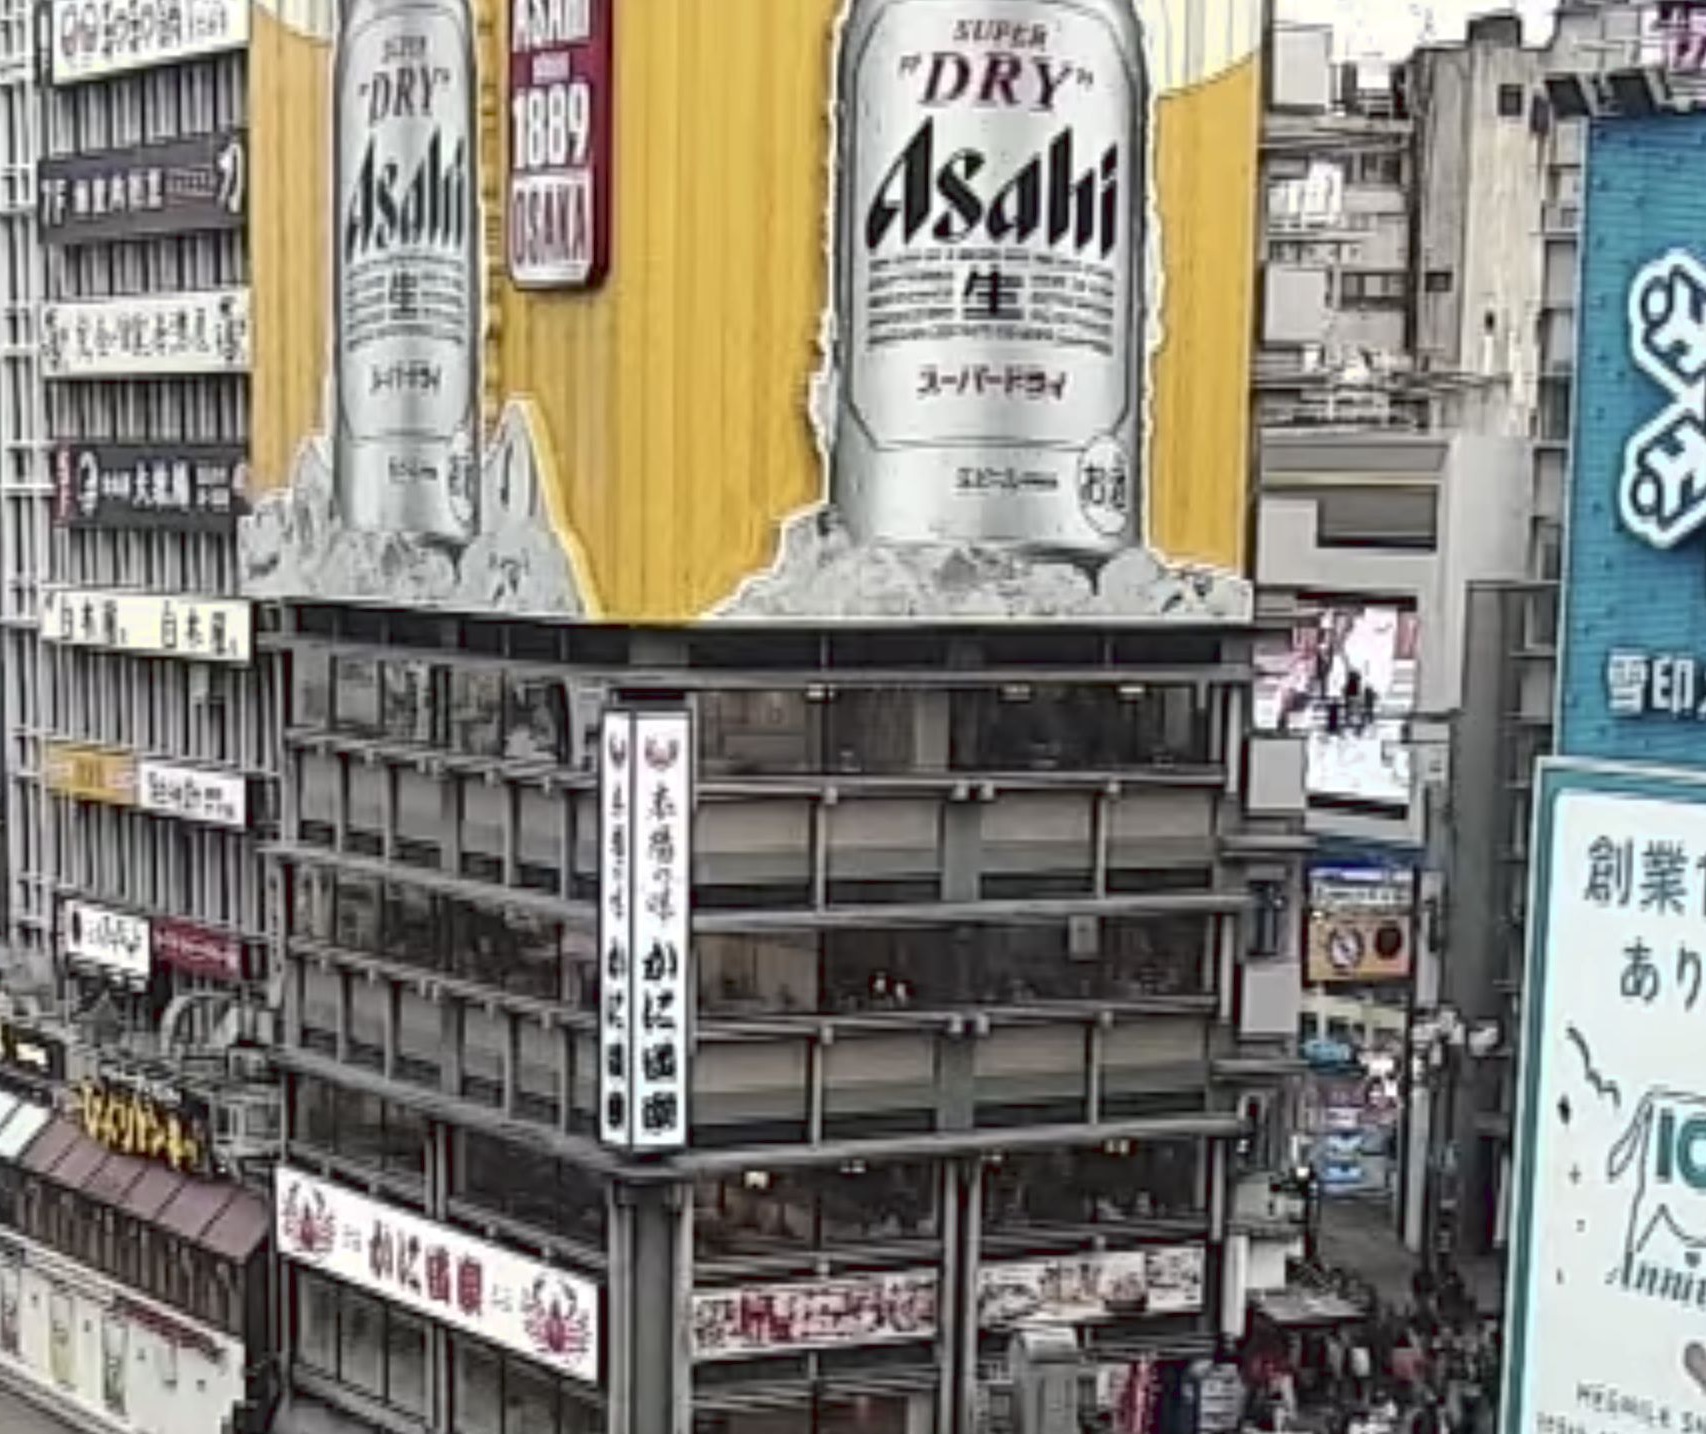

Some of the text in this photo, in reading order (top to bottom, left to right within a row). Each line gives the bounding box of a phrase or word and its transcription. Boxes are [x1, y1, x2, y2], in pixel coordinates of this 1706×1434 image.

[512, 80, 591, 170] 1889
[345, 124, 465, 264] Asahi
[865, 115, 1118, 260] Asahi
[961, 263, 1024, 320] 生
